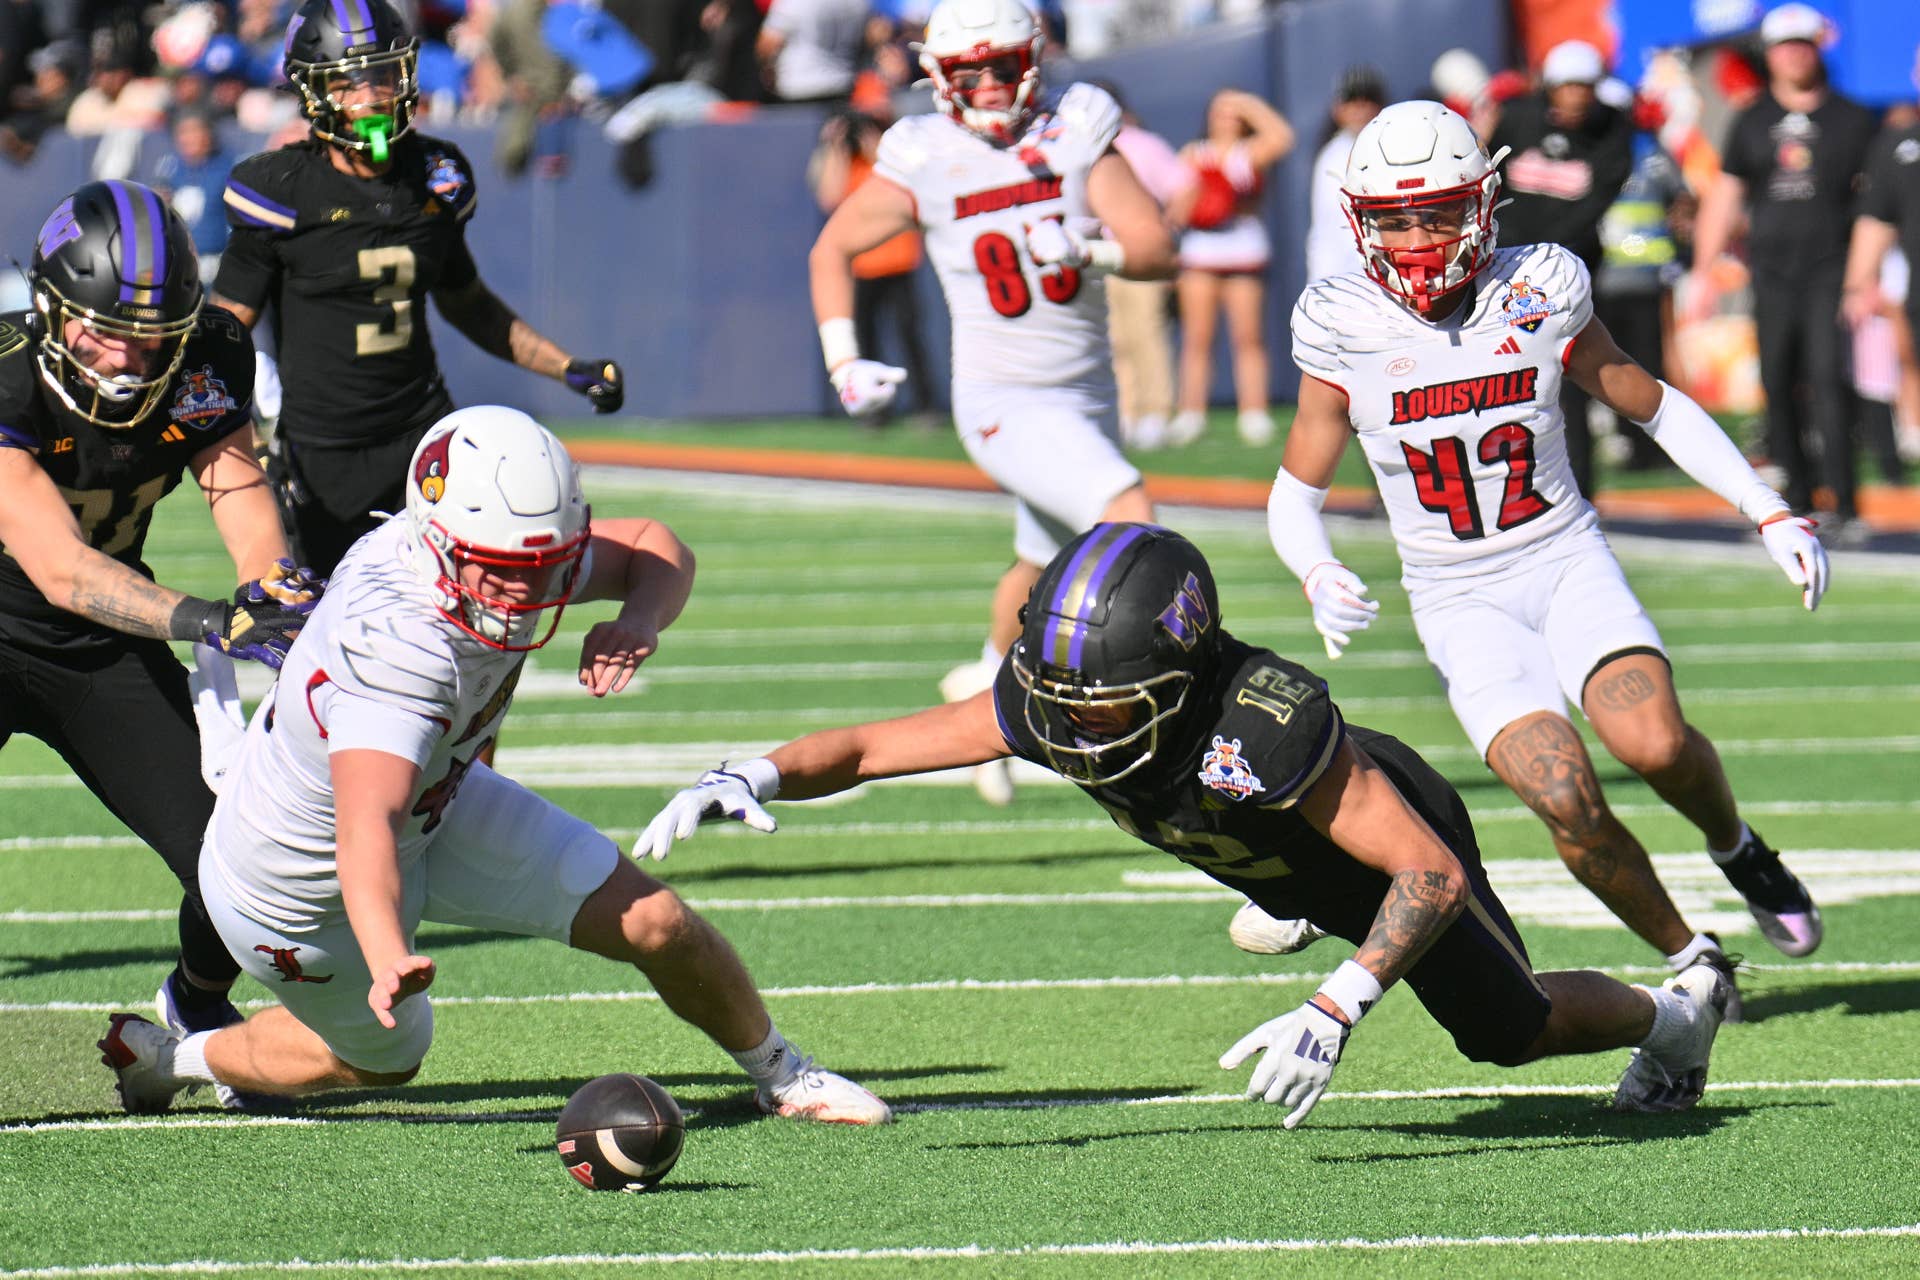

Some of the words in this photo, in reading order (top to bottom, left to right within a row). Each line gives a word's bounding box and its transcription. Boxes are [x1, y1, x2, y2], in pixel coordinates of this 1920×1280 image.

[356, 246, 416, 356] 3
[1389, 367, 1539, 425] LOUISVILLE
[1400, 422, 1555, 540] 42
[1152, 571, 1210, 652] W
[1237, 665, 1316, 725] 12
[1424, 870, 1449, 891] SKY
